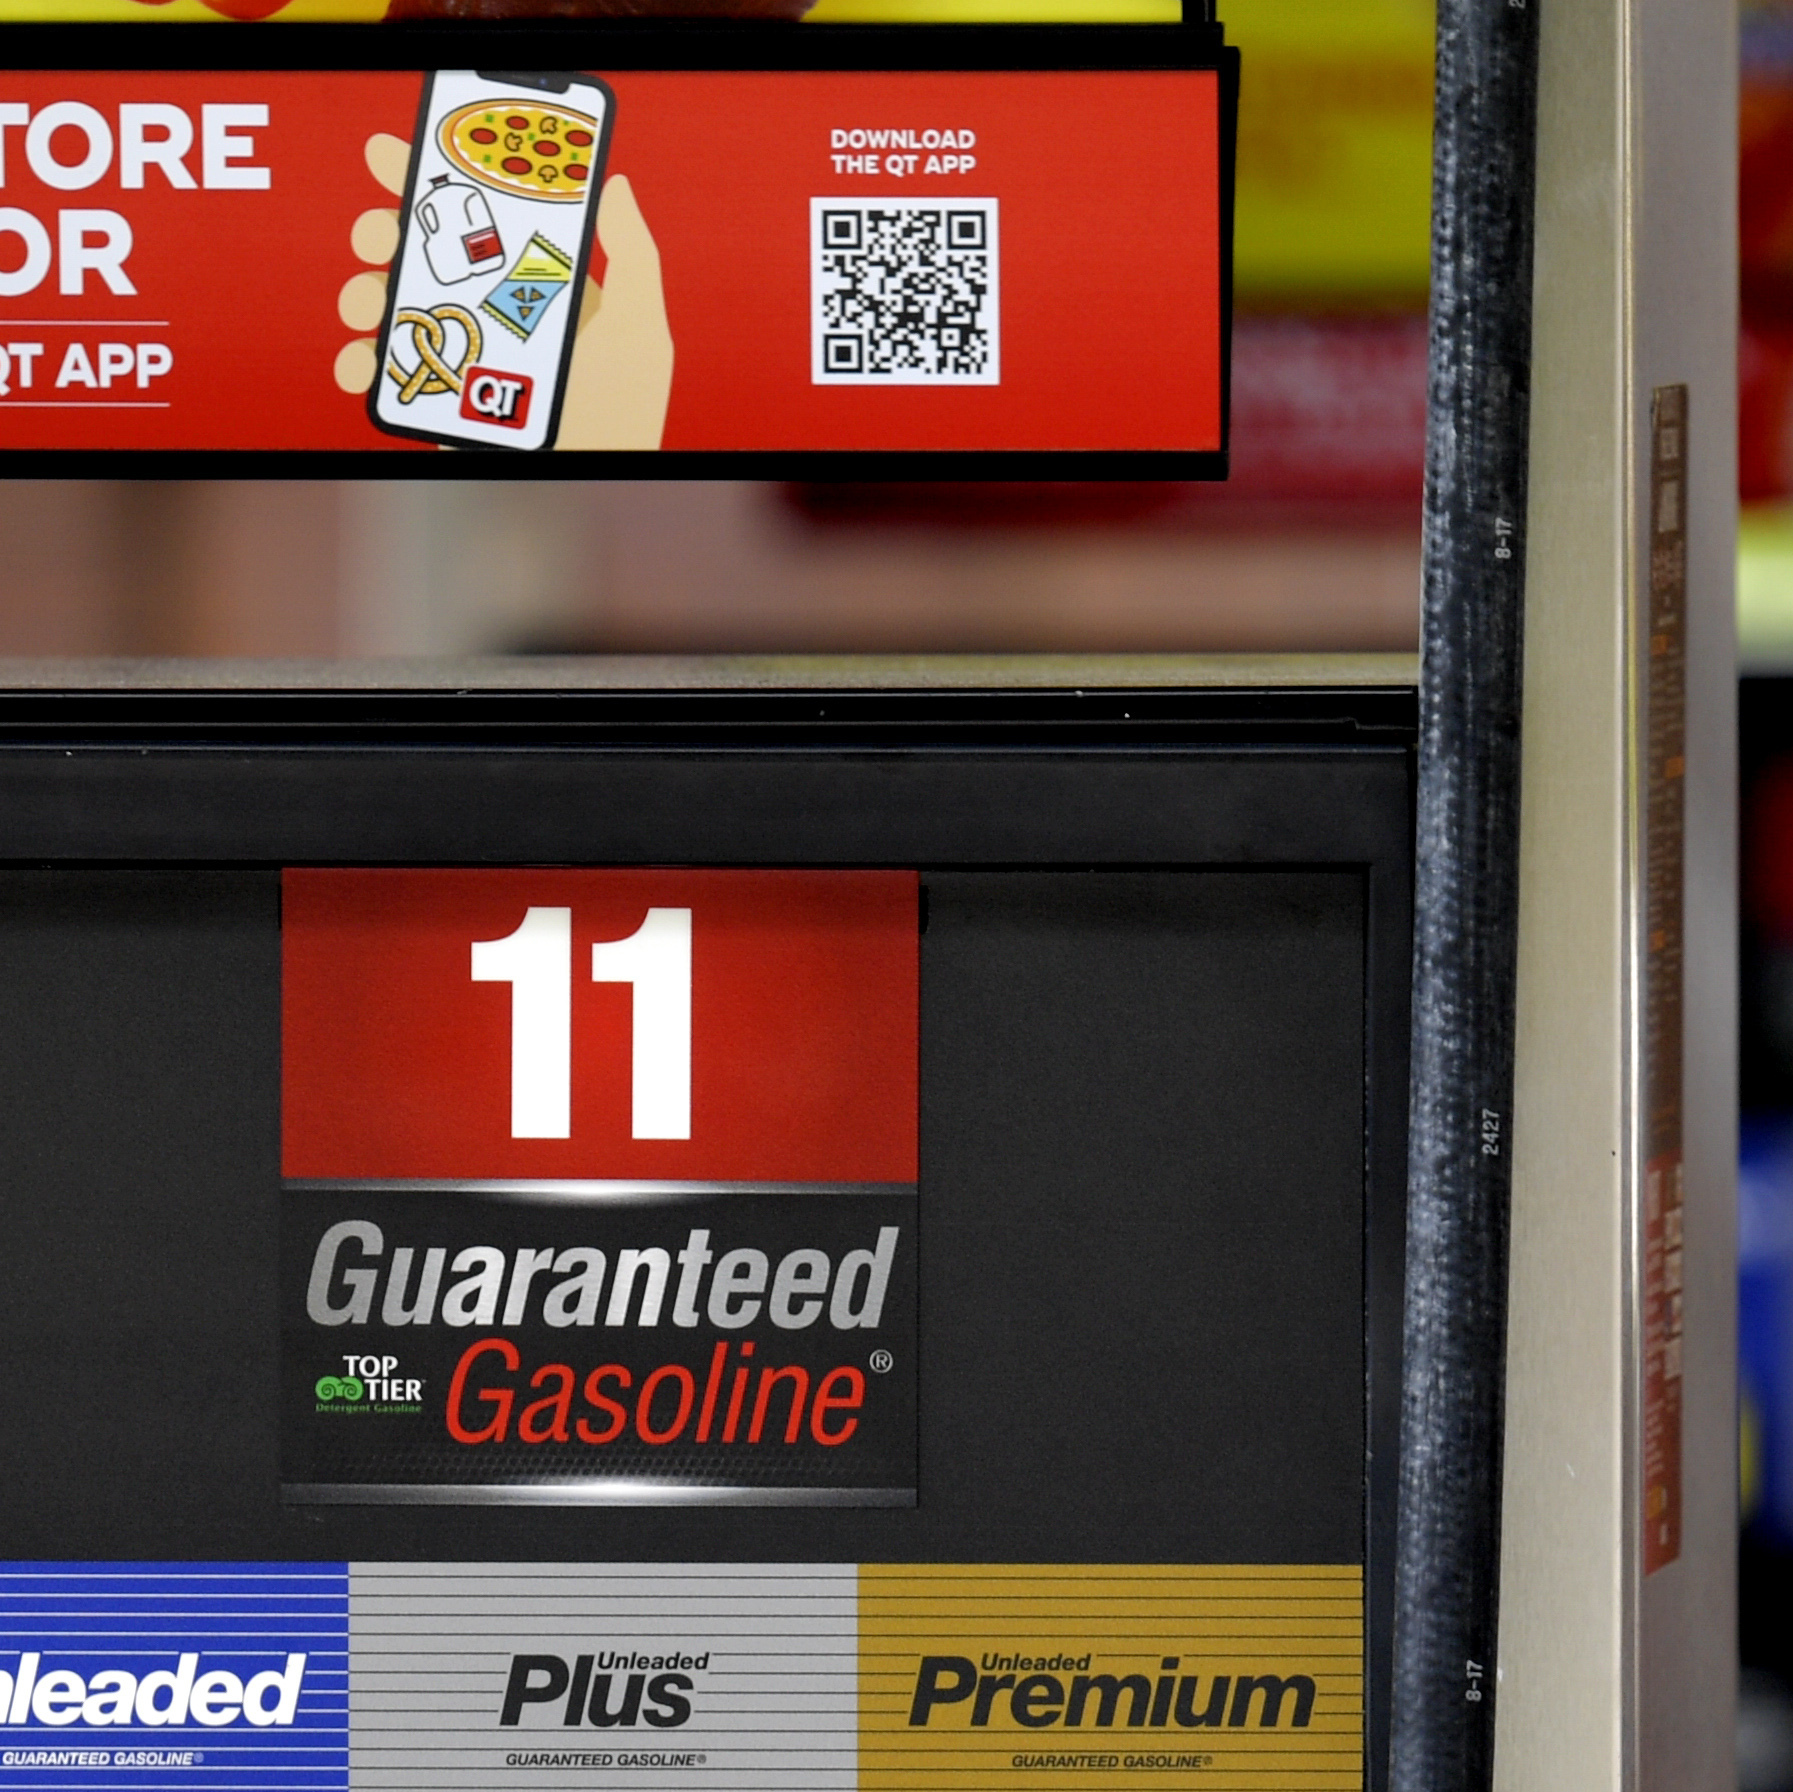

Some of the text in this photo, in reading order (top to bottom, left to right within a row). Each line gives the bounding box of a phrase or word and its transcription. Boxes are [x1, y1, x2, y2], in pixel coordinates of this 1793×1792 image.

[832, 129, 975, 149] DOWNLOAD
[831, 155, 975, 177] THE QT APP
[56, 343, 173, 388] APP
[469, 376, 524, 420] QT
[1495, 517, 1512, 558] 8-17
[471, 907, 691, 1139] 11
[1481, 1108, 1500, 1155] 2427
[308, 1221, 898, 1329] Guaranteed
[342, 1355, 398, 1377] TOP
[597, 1652, 709, 1670] Unleaded
[499, 1654, 695, 1727] Plus
[909, 1656, 1317, 1728] Premium
